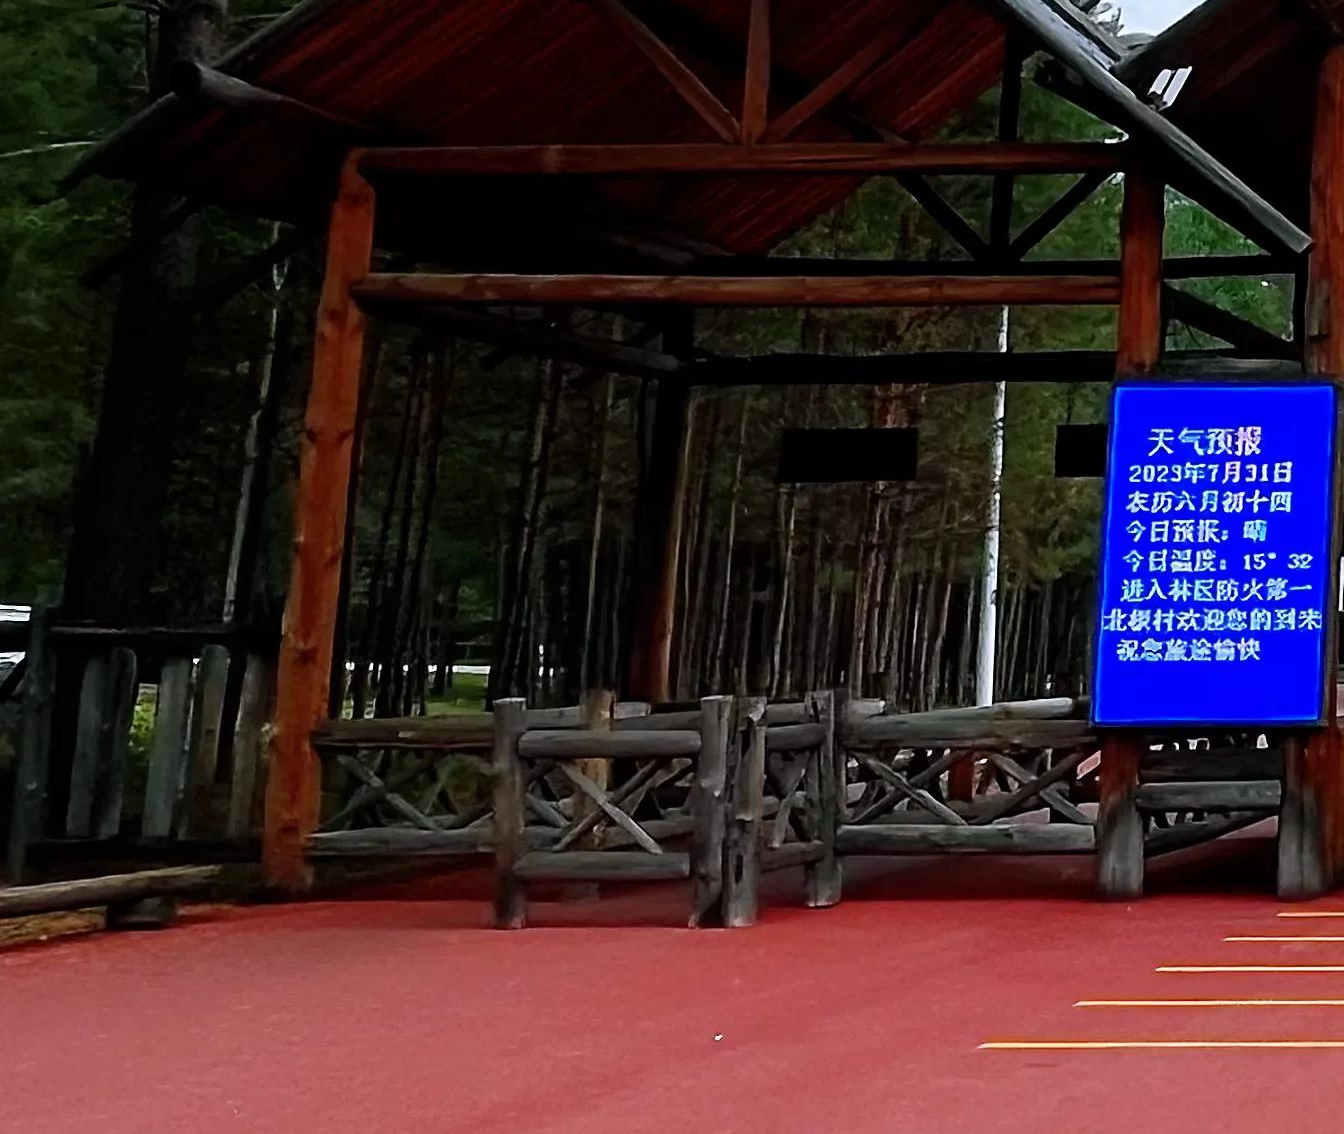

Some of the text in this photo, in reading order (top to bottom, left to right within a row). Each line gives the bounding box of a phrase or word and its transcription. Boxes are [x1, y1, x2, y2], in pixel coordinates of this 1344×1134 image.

[1148, 426, 1262, 457] 天气预报
[1128, 461, 1293, 485] 2023年7月31日
[1126, 489, 1293, 514] 农历六月初十四
[1120, 578, 1313, 603] 进入林区防火第一
[1103, 608, 1322, 632] 北极村欢迎您的到来
[1117, 637, 1261, 662] 祝您旅途愉快
